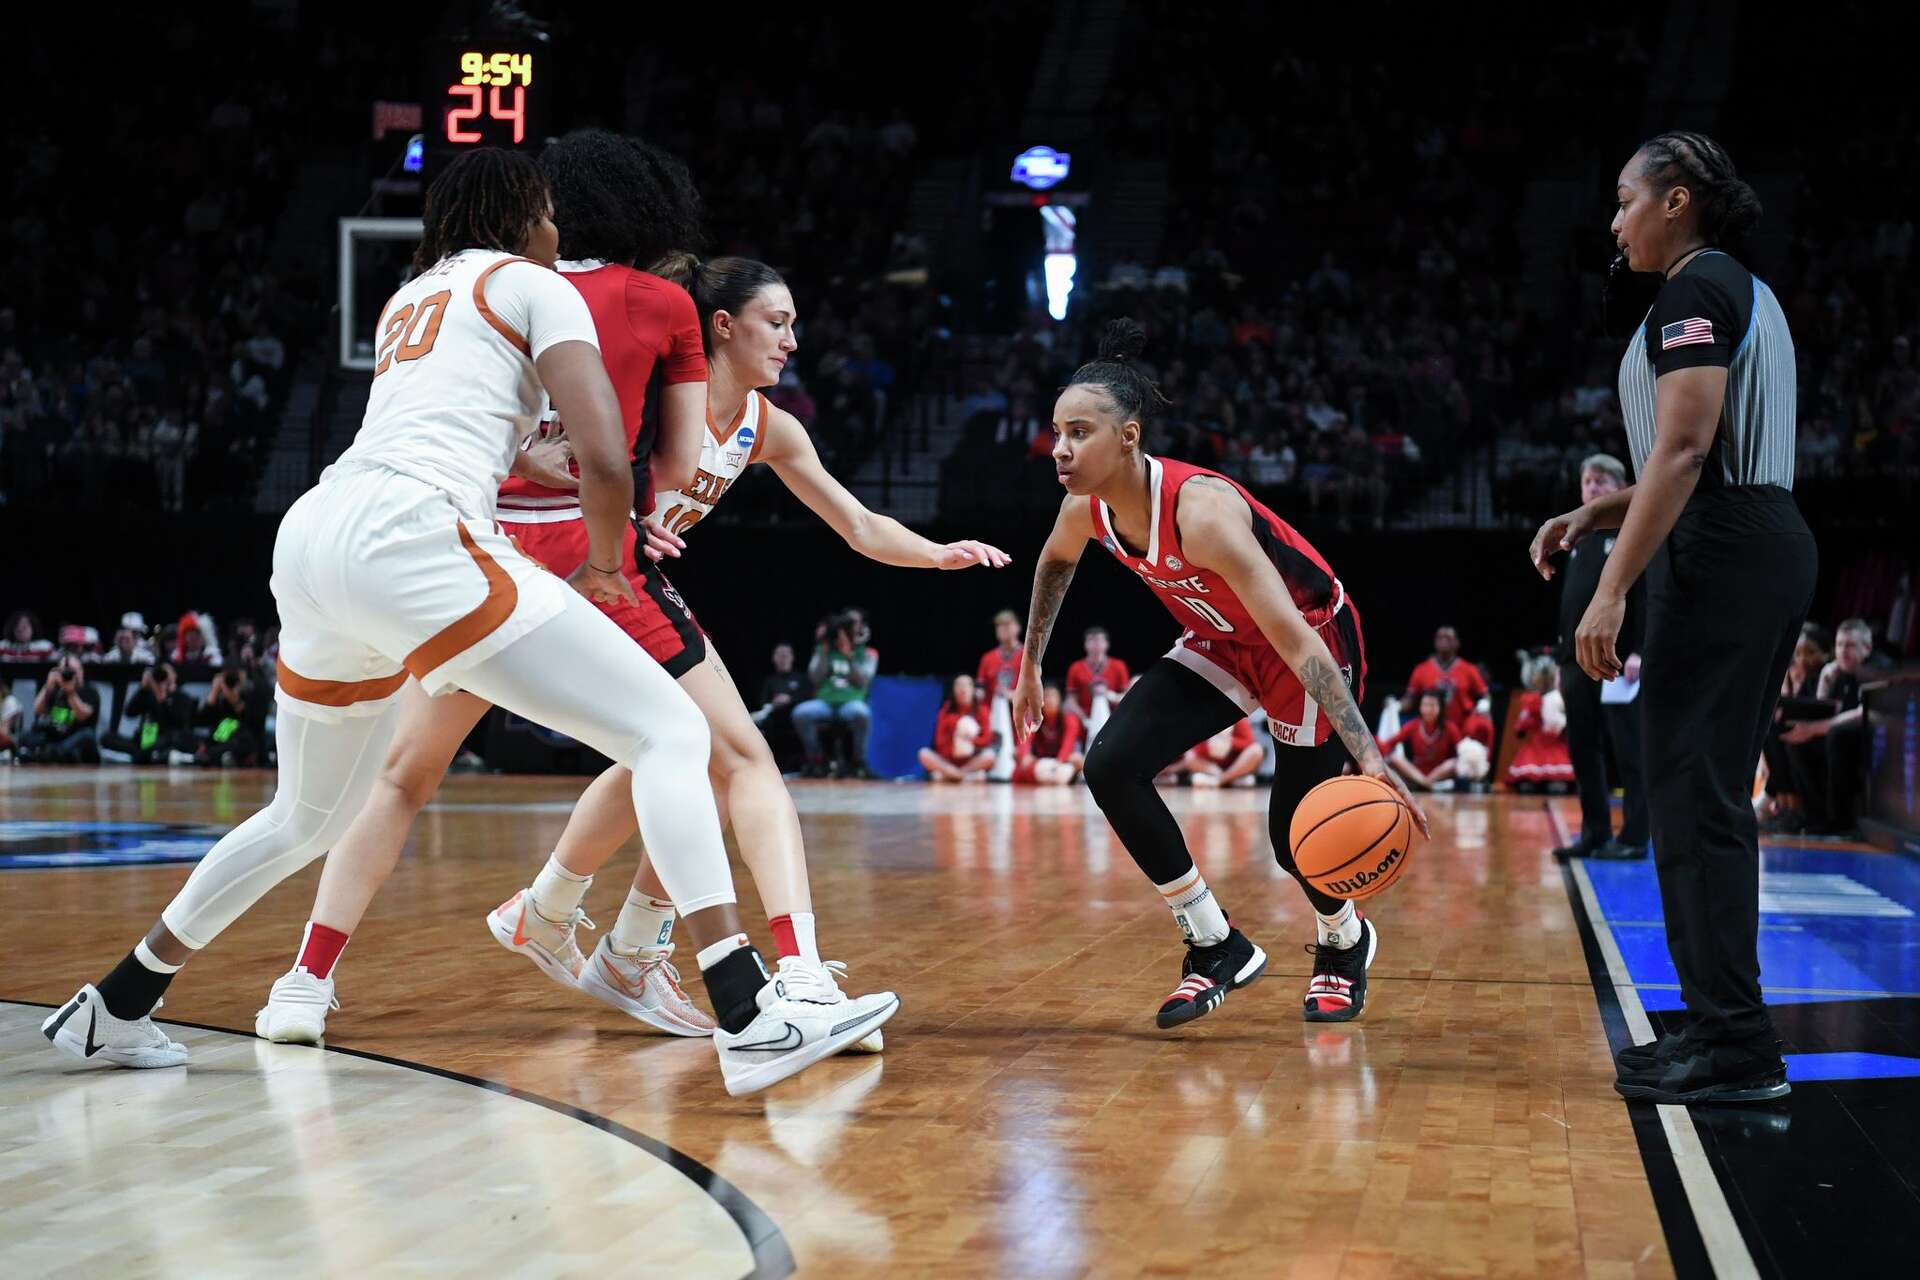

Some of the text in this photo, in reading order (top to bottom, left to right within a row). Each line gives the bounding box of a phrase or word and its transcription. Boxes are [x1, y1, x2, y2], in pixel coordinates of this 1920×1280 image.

[461, 52, 532, 87] 9:54
[447, 84, 525, 144] 24
[374, 289, 453, 377] 20
[1171, 594, 1234, 632] 10
[1273, 721, 1298, 744] PACK
[1324, 848, 1401, 895] Wilson
